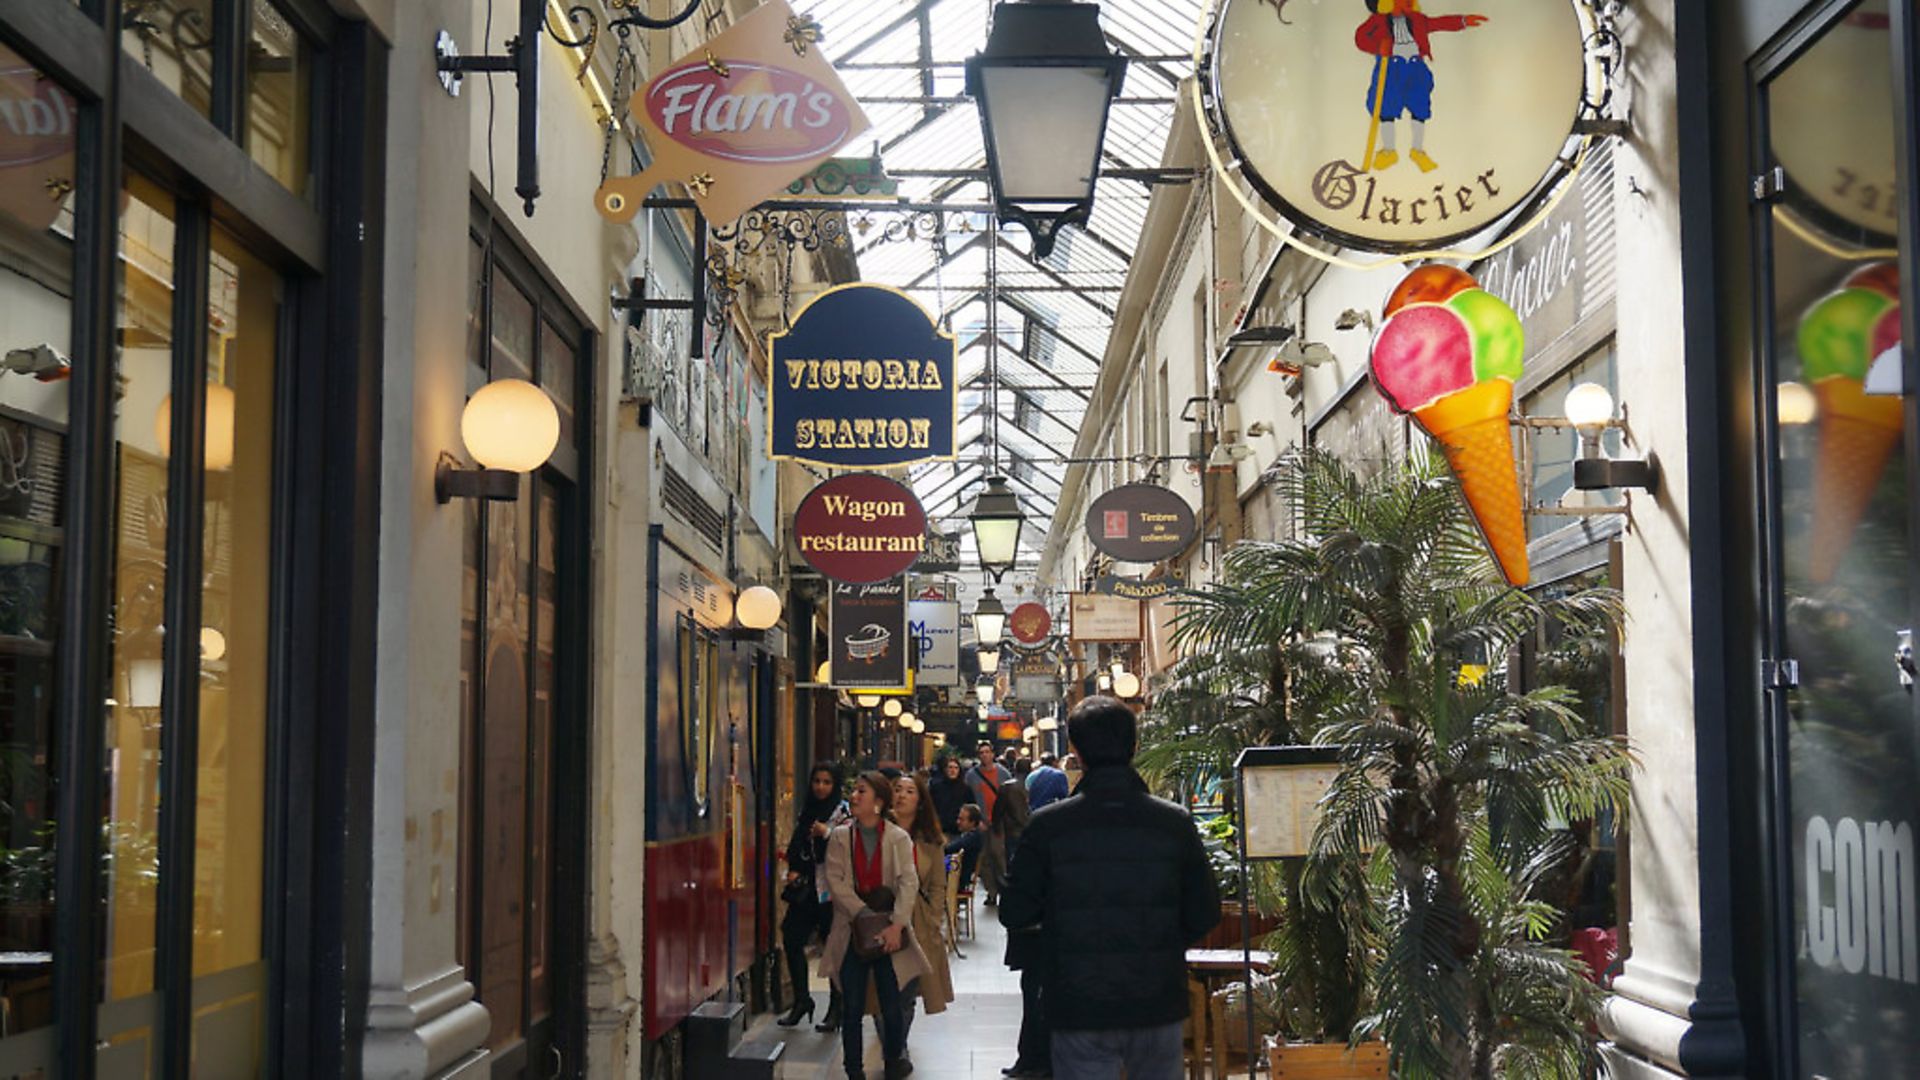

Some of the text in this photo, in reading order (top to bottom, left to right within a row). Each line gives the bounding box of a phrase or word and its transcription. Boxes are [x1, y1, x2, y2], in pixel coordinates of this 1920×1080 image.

[661, 79, 832, 135] Flam's
[1312, 159, 1501, 226] Glacier
[784, 359, 943, 391] VICTORIA
[796, 418, 932, 449] STATION
[822, 495, 906, 522] Wagon
[801, 532, 927, 552] restaurant
